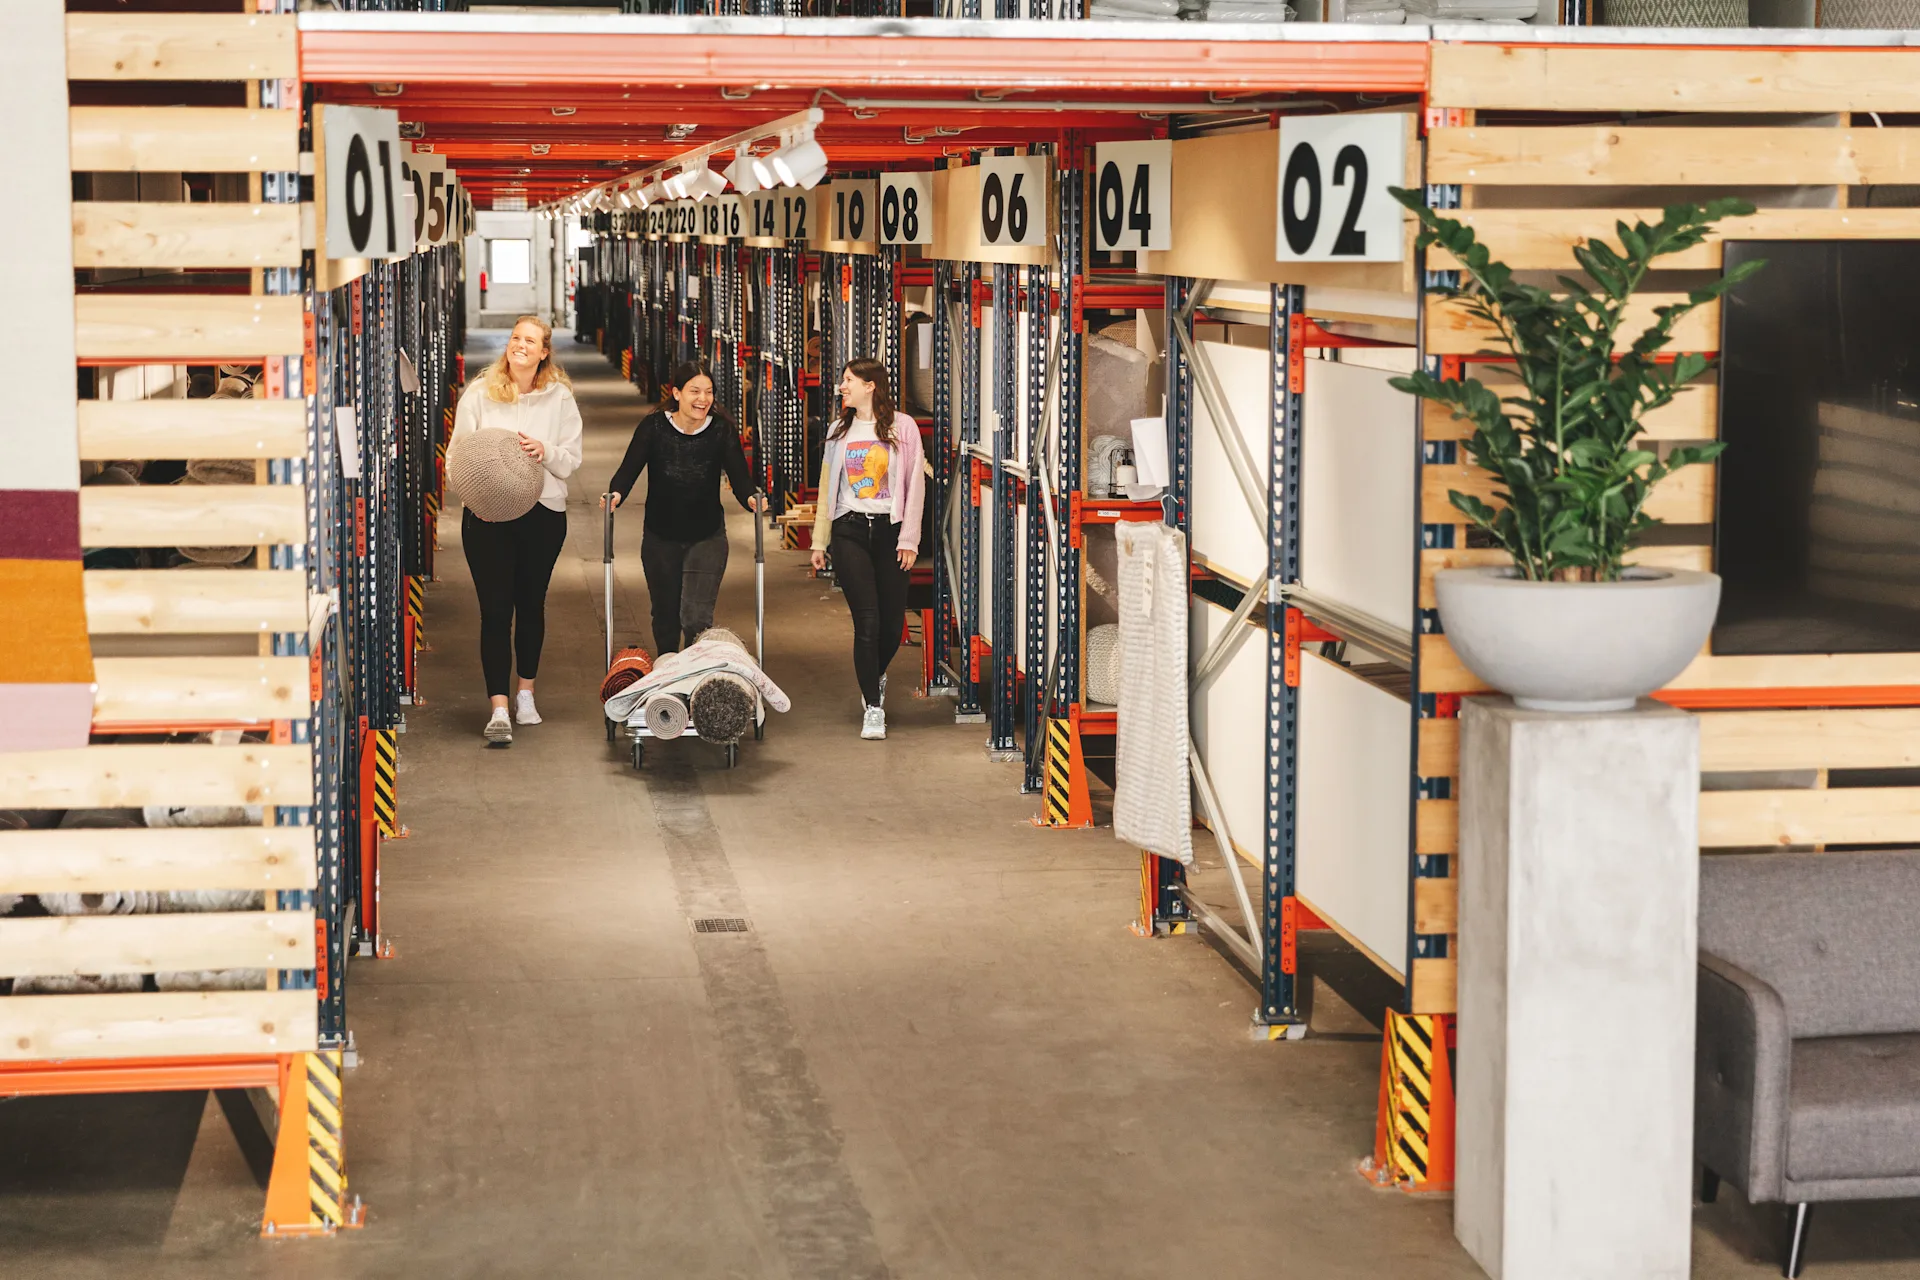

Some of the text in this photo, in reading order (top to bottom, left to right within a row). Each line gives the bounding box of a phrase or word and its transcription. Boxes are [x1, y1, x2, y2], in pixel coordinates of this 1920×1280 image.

[346, 133, 396, 253] 01
[836, 189, 864, 240] 10
[882, 184, 918, 241] 08
[982, 172, 1028, 243] 06
[1099, 161, 1151, 247] 04
[1283, 141, 1369, 256] 02
[650, 211, 664, 233] 24
[679, 207, 696, 233] 20
[703, 205, 718, 235] 18
[723, 203, 739, 235] 16
[754, 199, 774, 236] 14
[783, 196, 806, 238] 12
